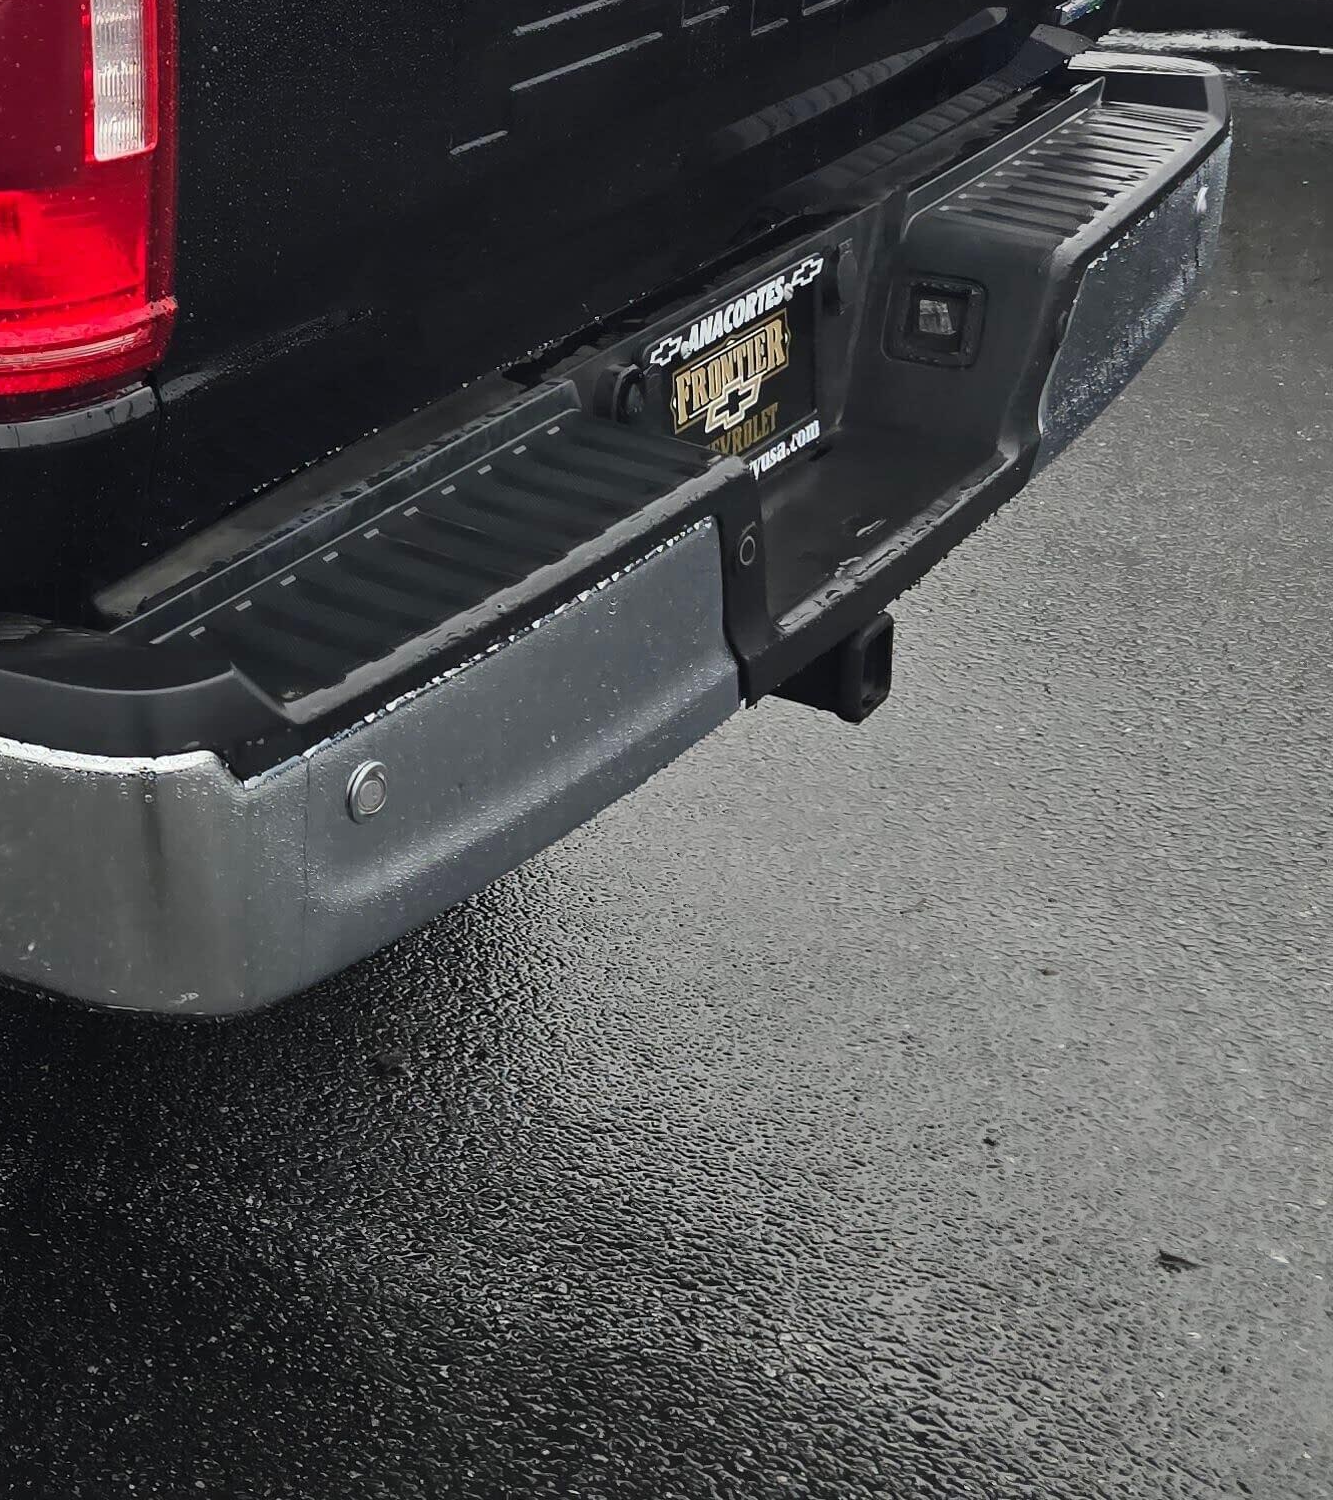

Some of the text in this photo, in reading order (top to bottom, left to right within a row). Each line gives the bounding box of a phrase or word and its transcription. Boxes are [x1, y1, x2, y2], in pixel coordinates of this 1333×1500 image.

[687, 275, 786, 353] ANACORTES
[675, 318, 787, 426] FRONTIER
[708, 402, 779, 456] EVROLET
